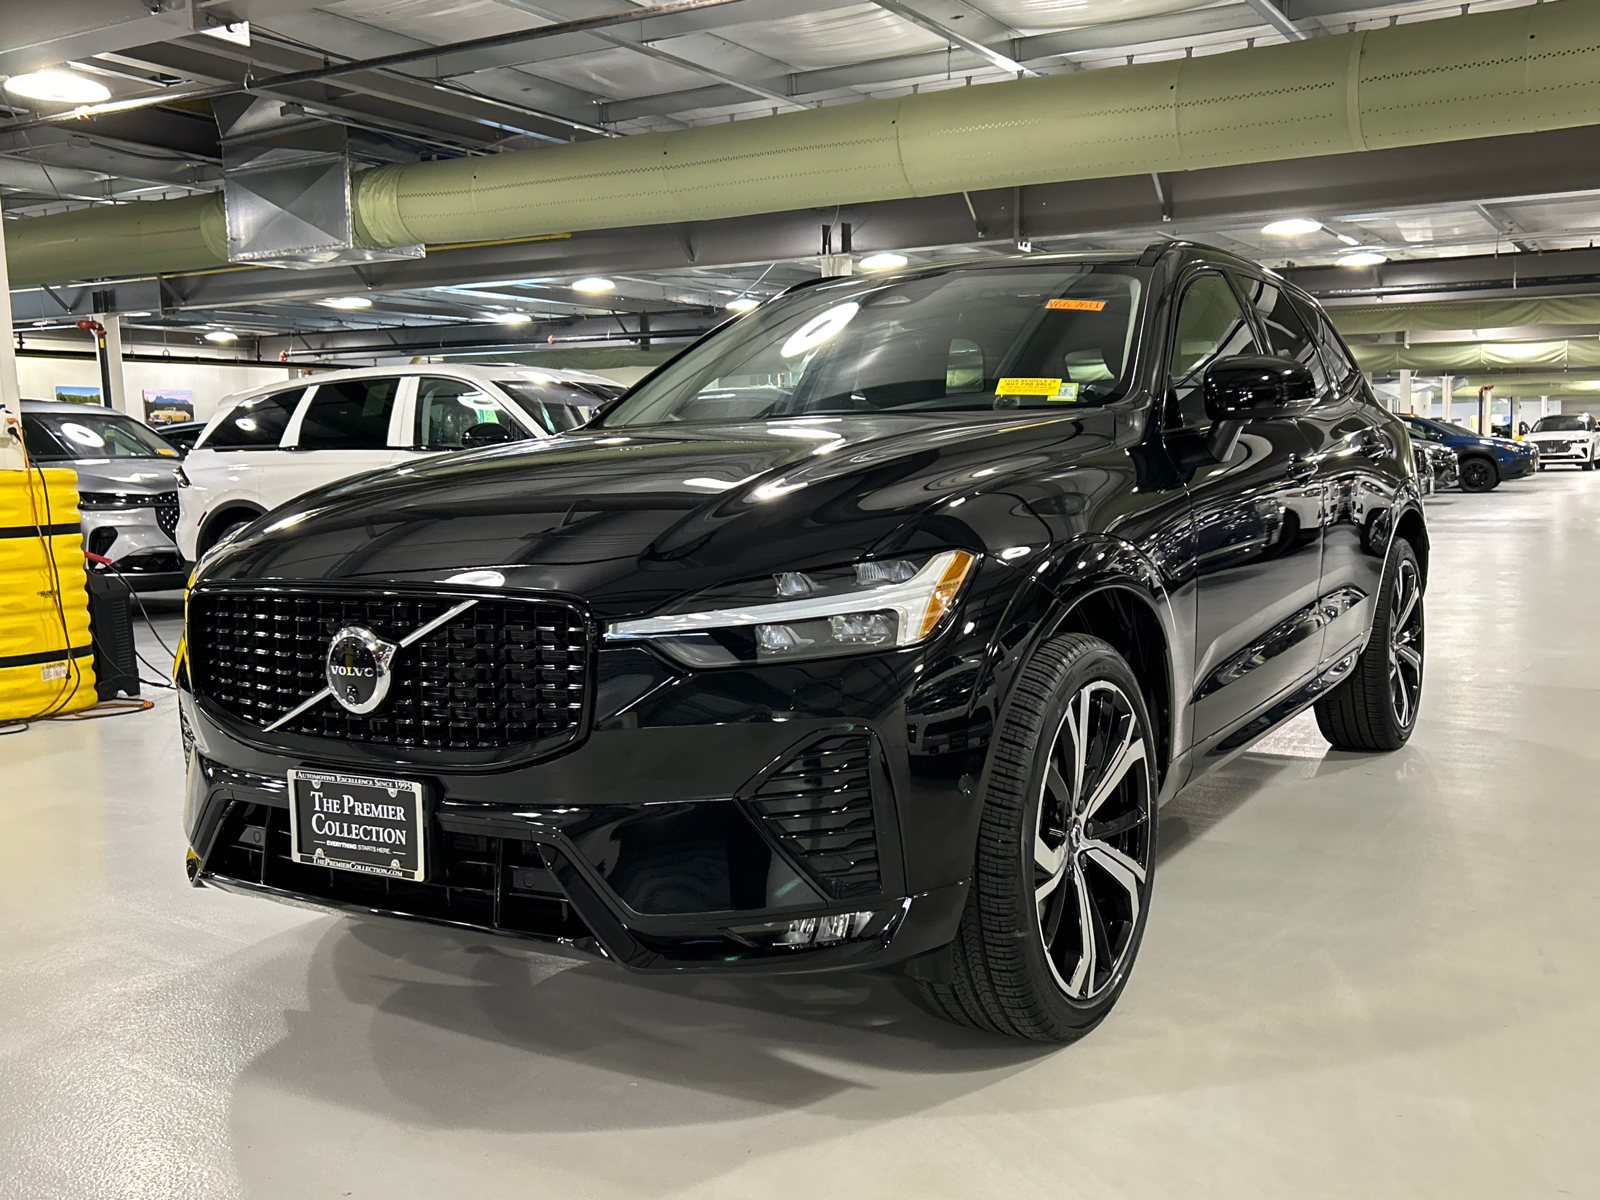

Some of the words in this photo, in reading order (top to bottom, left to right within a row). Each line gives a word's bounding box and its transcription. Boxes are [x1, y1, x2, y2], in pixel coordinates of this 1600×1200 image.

[330, 665, 375, 677] VOLVO
[297, 771, 336, 782] AUTOMOTIVE
[336, 775, 374, 786] EXCELLENCE
[374, 778, 393, 788] SINCE
[394, 781, 412, 791] 1995
[310, 791, 341, 813] THE
[342, 795, 406, 821] PREMIER
[311, 813, 406, 845] COLLECTION
[326, 840, 357, 850] EVERYTHING
[357, 844, 377, 853] STARTS
[312, 857, 403, 877] THEPREMIERCOLLECTION.COM
